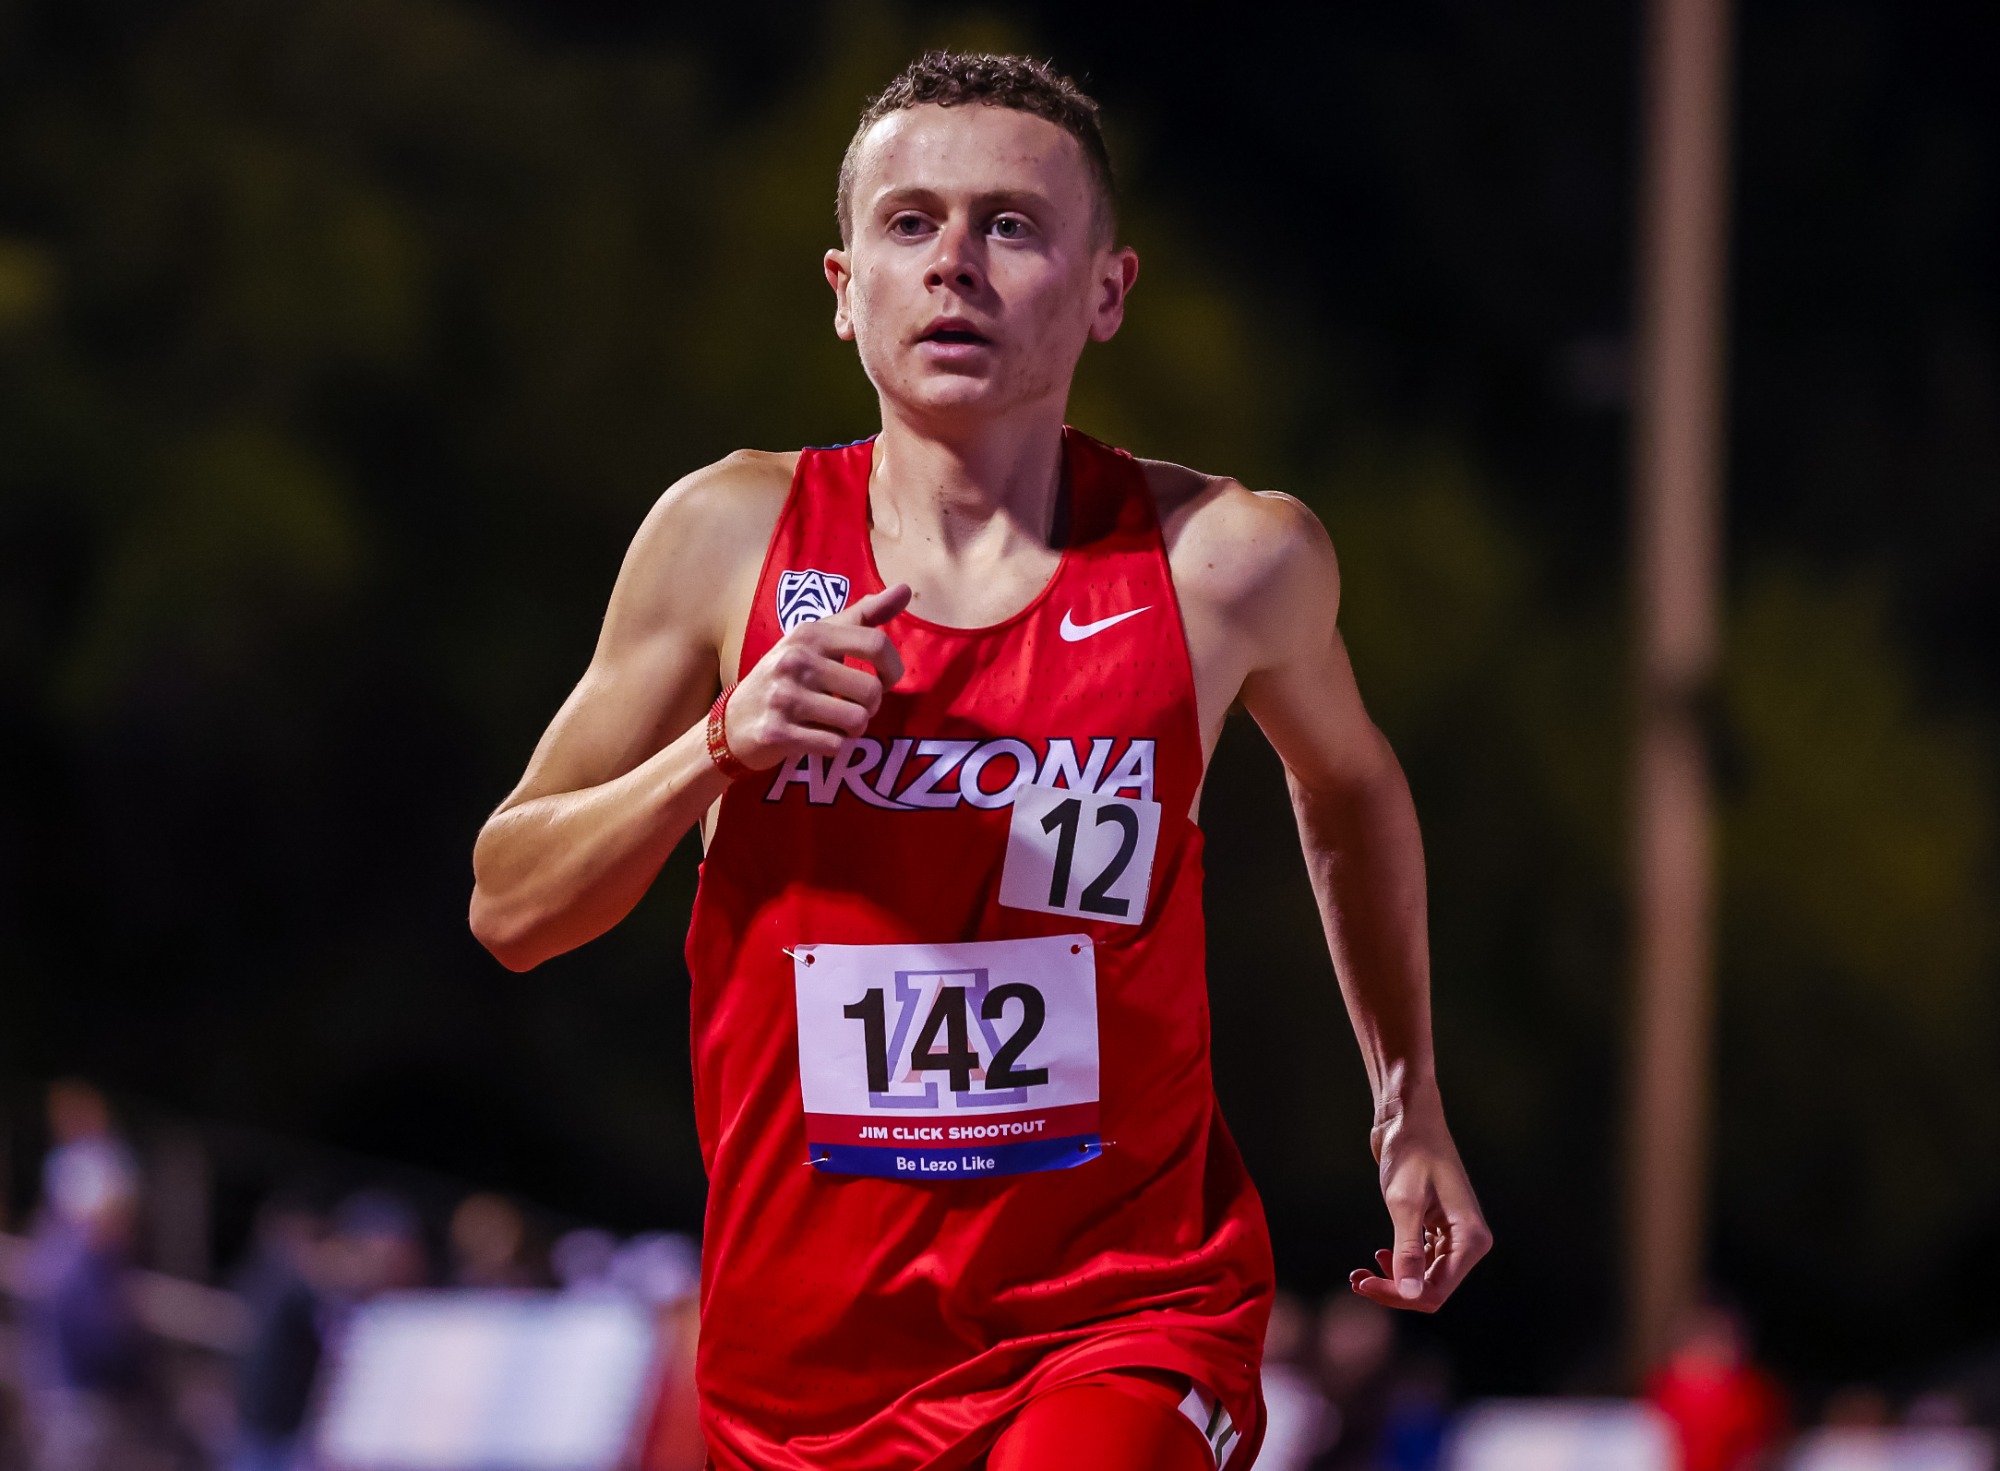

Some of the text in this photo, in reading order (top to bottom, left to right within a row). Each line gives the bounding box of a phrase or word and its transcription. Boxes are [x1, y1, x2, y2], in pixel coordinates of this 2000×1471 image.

[780, 572, 847, 612] PAC
[765, 737, 1156, 811] ARIZONA
[1040, 797, 1140, 917] 12
[842, 982, 1049, 1093] 142
[858, 1119, 1046, 1140] JIM CLICK SHOOTOUT
[896, 1155, 995, 1172] Be Lezo Like
